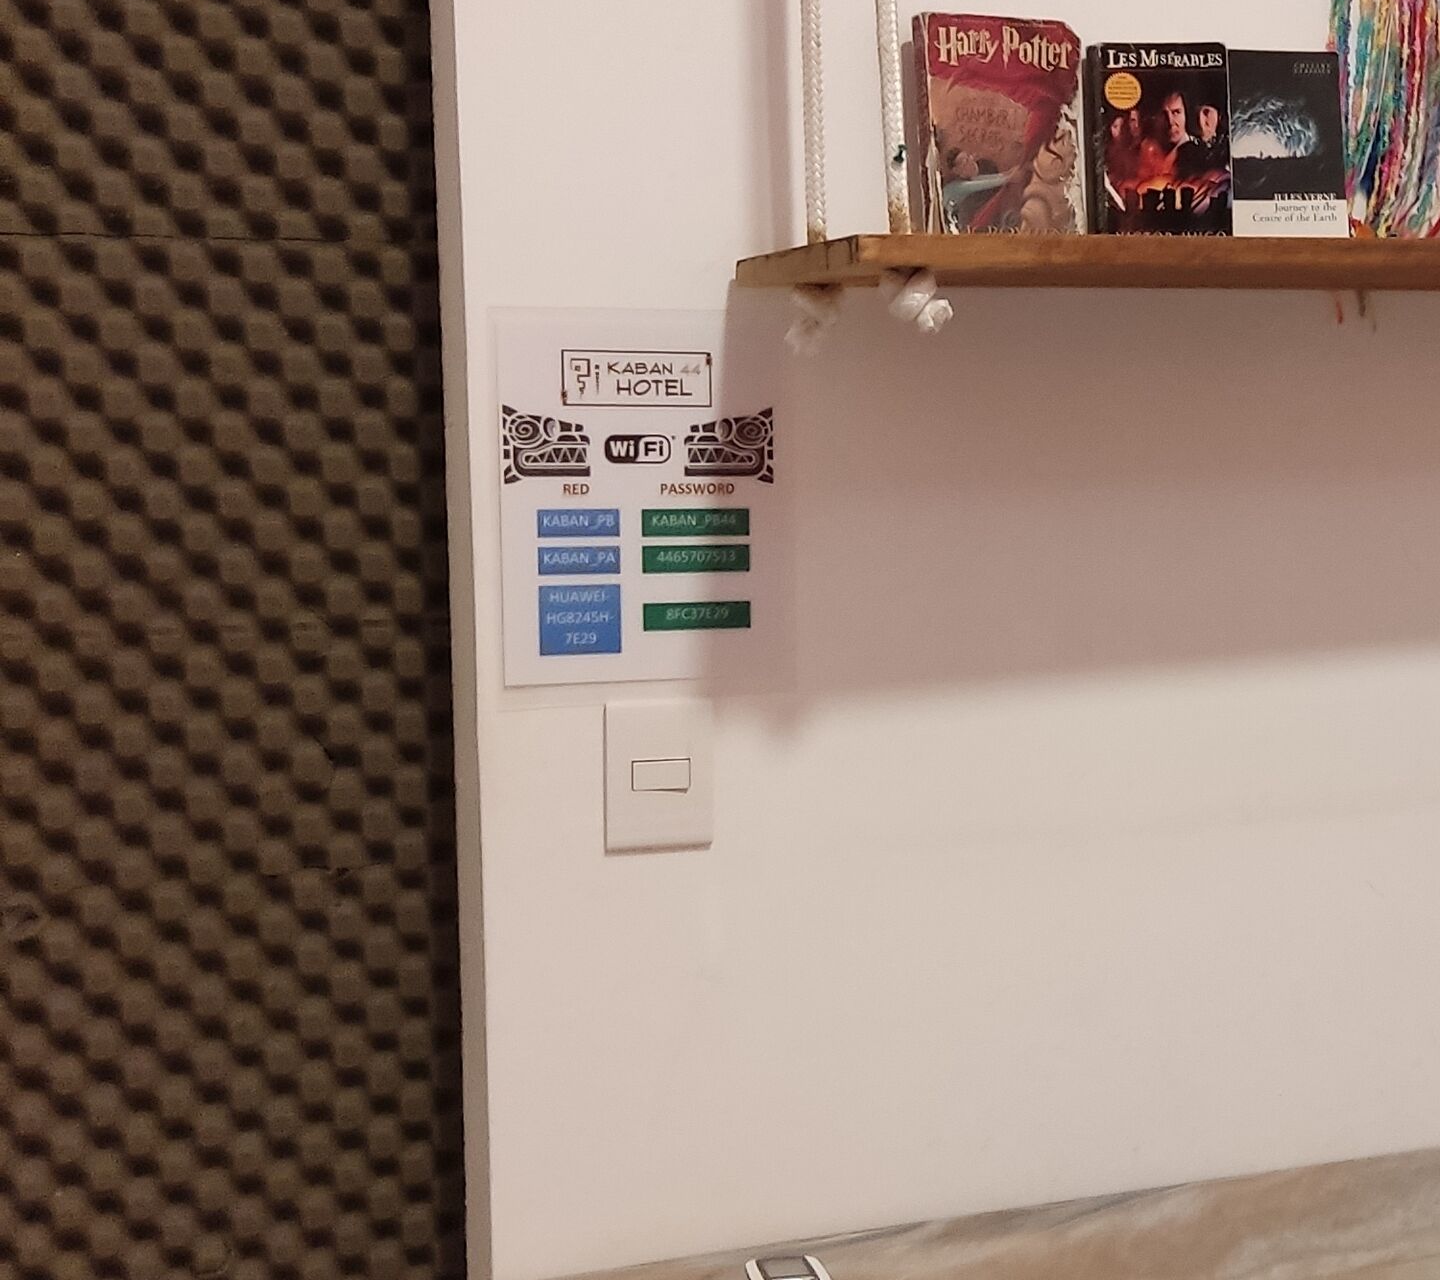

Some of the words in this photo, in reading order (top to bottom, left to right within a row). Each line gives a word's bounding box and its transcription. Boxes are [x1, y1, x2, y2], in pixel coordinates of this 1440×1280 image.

[934, 26, 999, 66] Harry
[1002, 26, 1072, 72] Potter
[1106, 50, 1137, 68] LES
[1303, 193, 1336, 201] VERNE
[1274, 202, 1307, 213] Journey
[1323, 202, 1336, 211] the
[1252, 213, 1282, 222] Centre
[1284, 213, 1294, 222] of
[1296, 213, 1310, 222] the
[1313, 213, 1337, 222] Earth
[607, 362, 673, 375] KABAN
[616, 378, 693, 396] HOTEL
[563, 483, 590, 495] RED
[660, 483, 735, 495] PASSWORD
